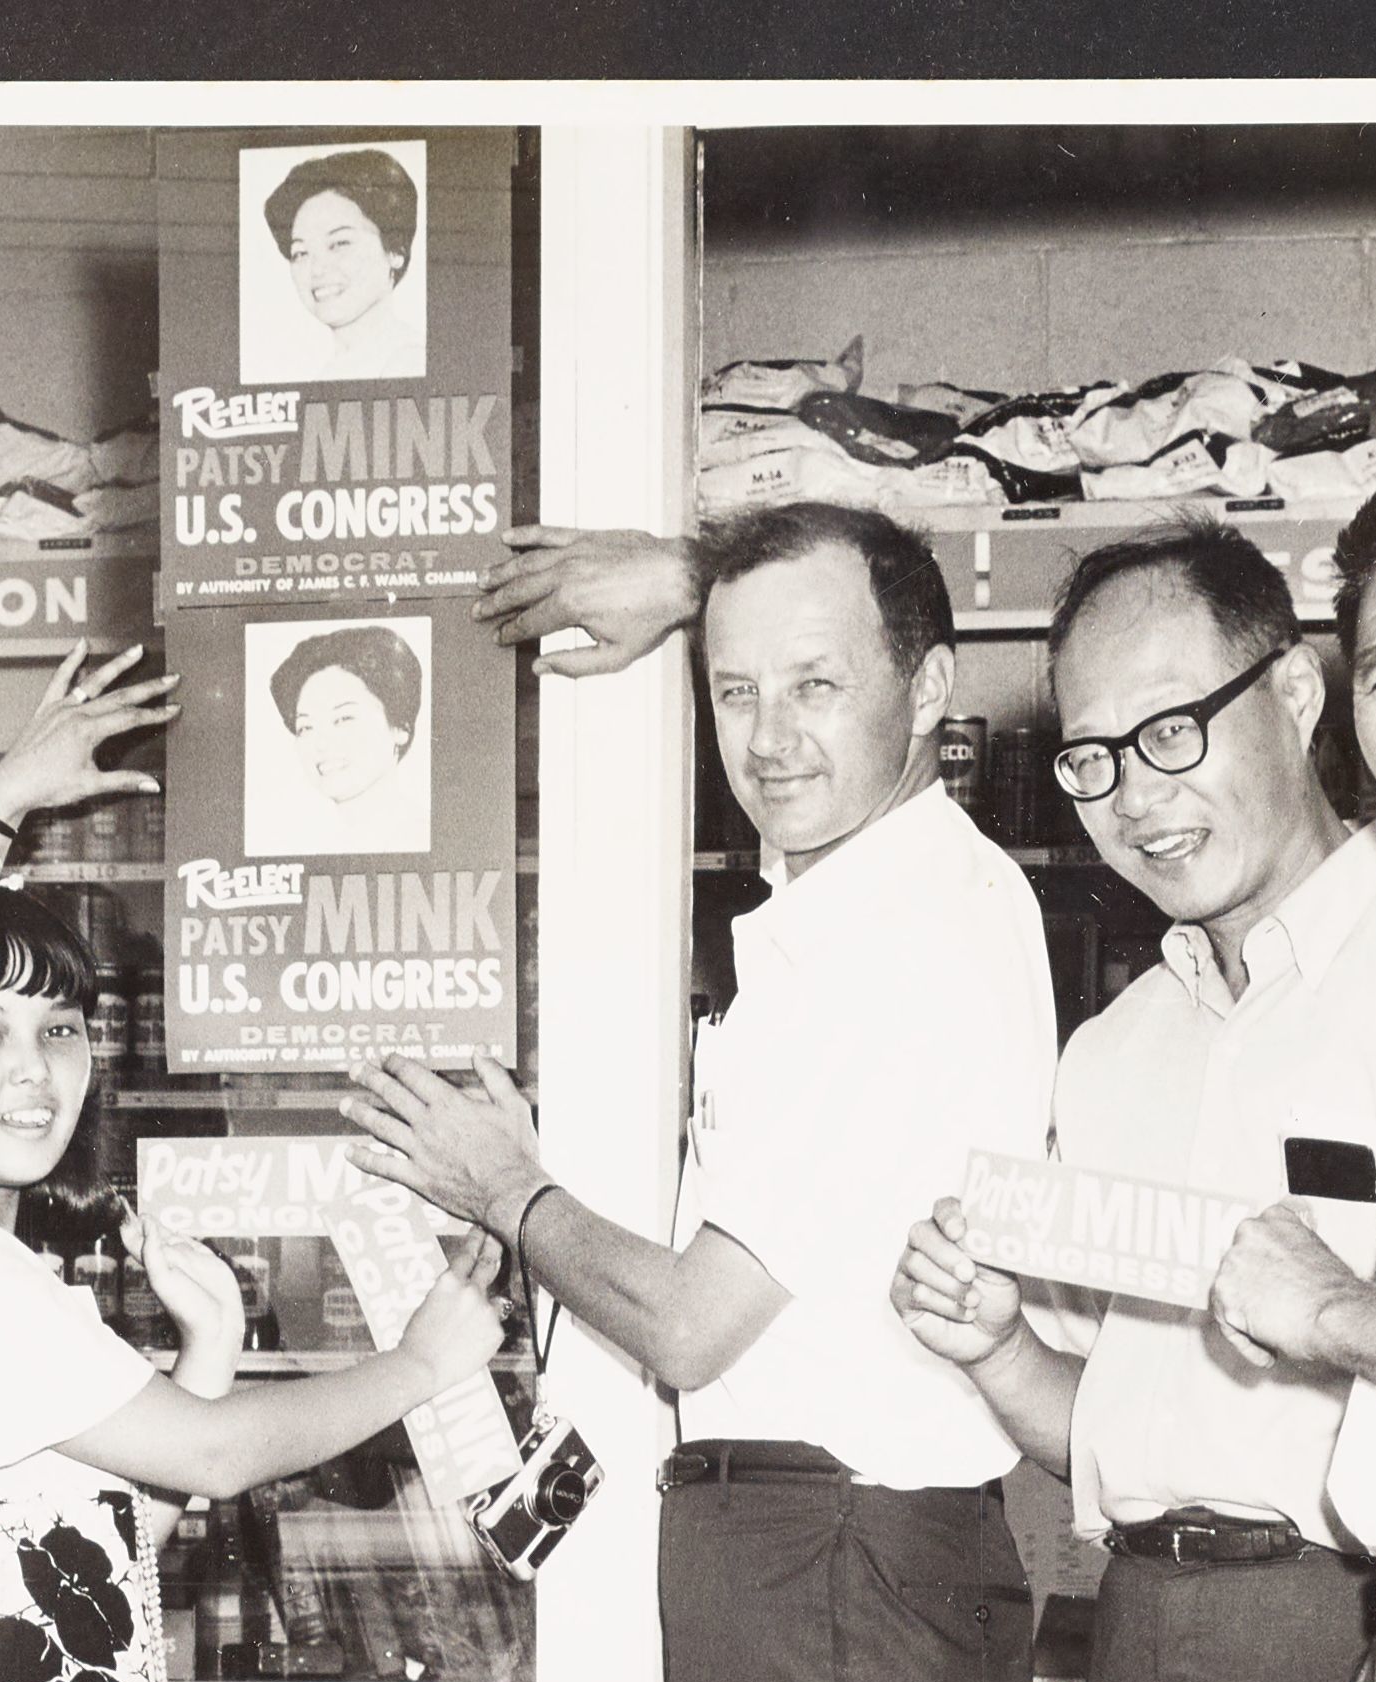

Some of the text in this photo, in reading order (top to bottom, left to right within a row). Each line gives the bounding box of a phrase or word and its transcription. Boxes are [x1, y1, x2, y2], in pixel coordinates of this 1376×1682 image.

[176, 394, 498, 488] PATSY MINK
[175, 483, 498, 545] U.S. CONGRESS
[176, 582, 192, 595] BY
[199, 579, 271, 594] AUTHORITY
[276, 577, 294, 591] OF
[298, 576, 340, 590] JAMES
[423, 571, 479, 585] CHAIRM
[235, 550, 440, 575] DEMOCRAT
[180, 869, 502, 957] PATSY MINK
[178, 958, 503, 1014] U.S. CONGRESS
[181, 1050, 201, 1063] BY
[204, 1048, 277, 1062] AUTHORITY
[280, 1048, 299, 1061] OF
[240, 1023, 444, 1046] DEMOCRAT
[141, 1142, 273, 1206] Patsy
[969, 1157, 1063, 1240] Patsy
[966, 1228, 1200, 1296] CONGRESS
[431, 1366, 521, 1488] INK
